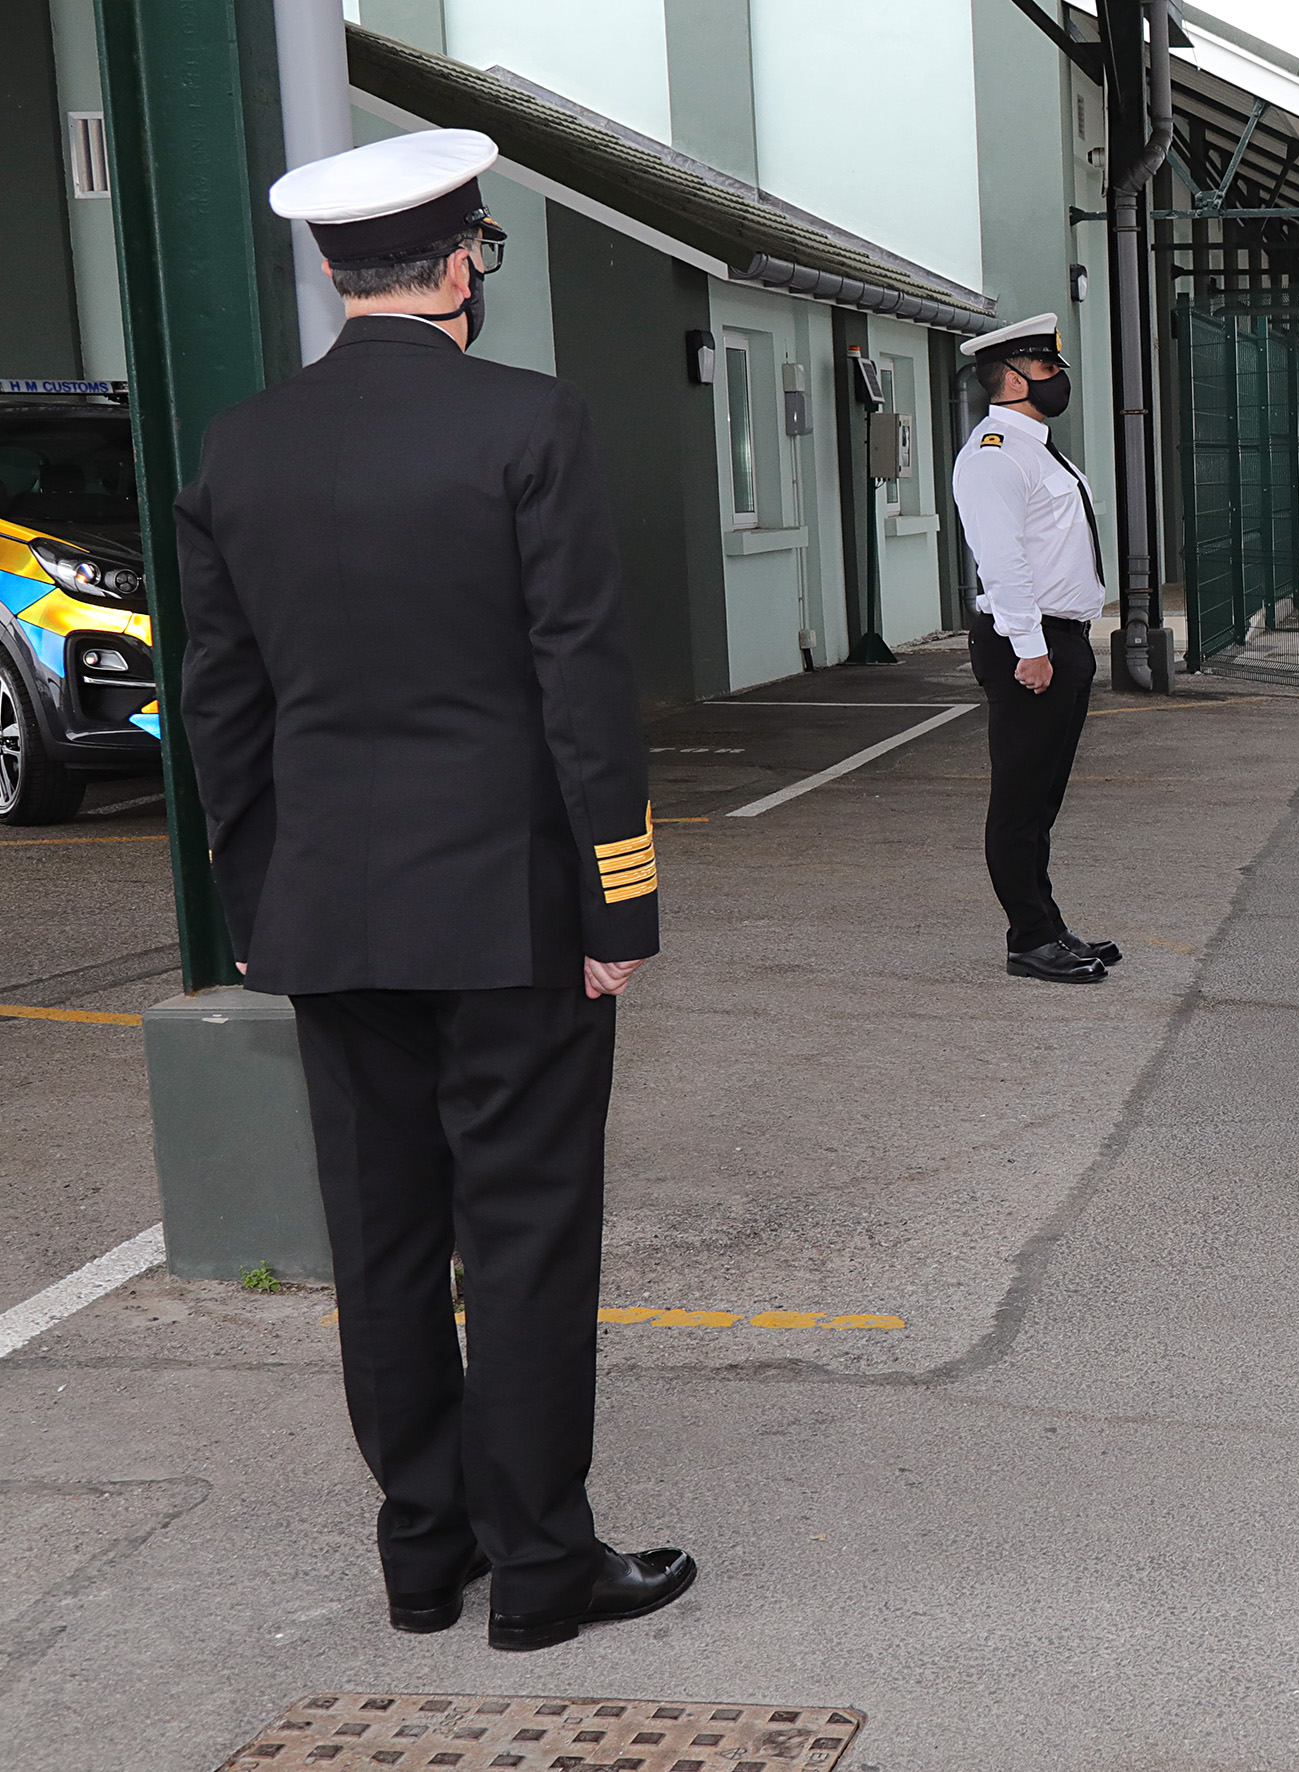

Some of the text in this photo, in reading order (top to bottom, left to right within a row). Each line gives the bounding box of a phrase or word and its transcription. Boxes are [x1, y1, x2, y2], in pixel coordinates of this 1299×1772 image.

[10, 381, 109, 393] H M CUSTOMS
